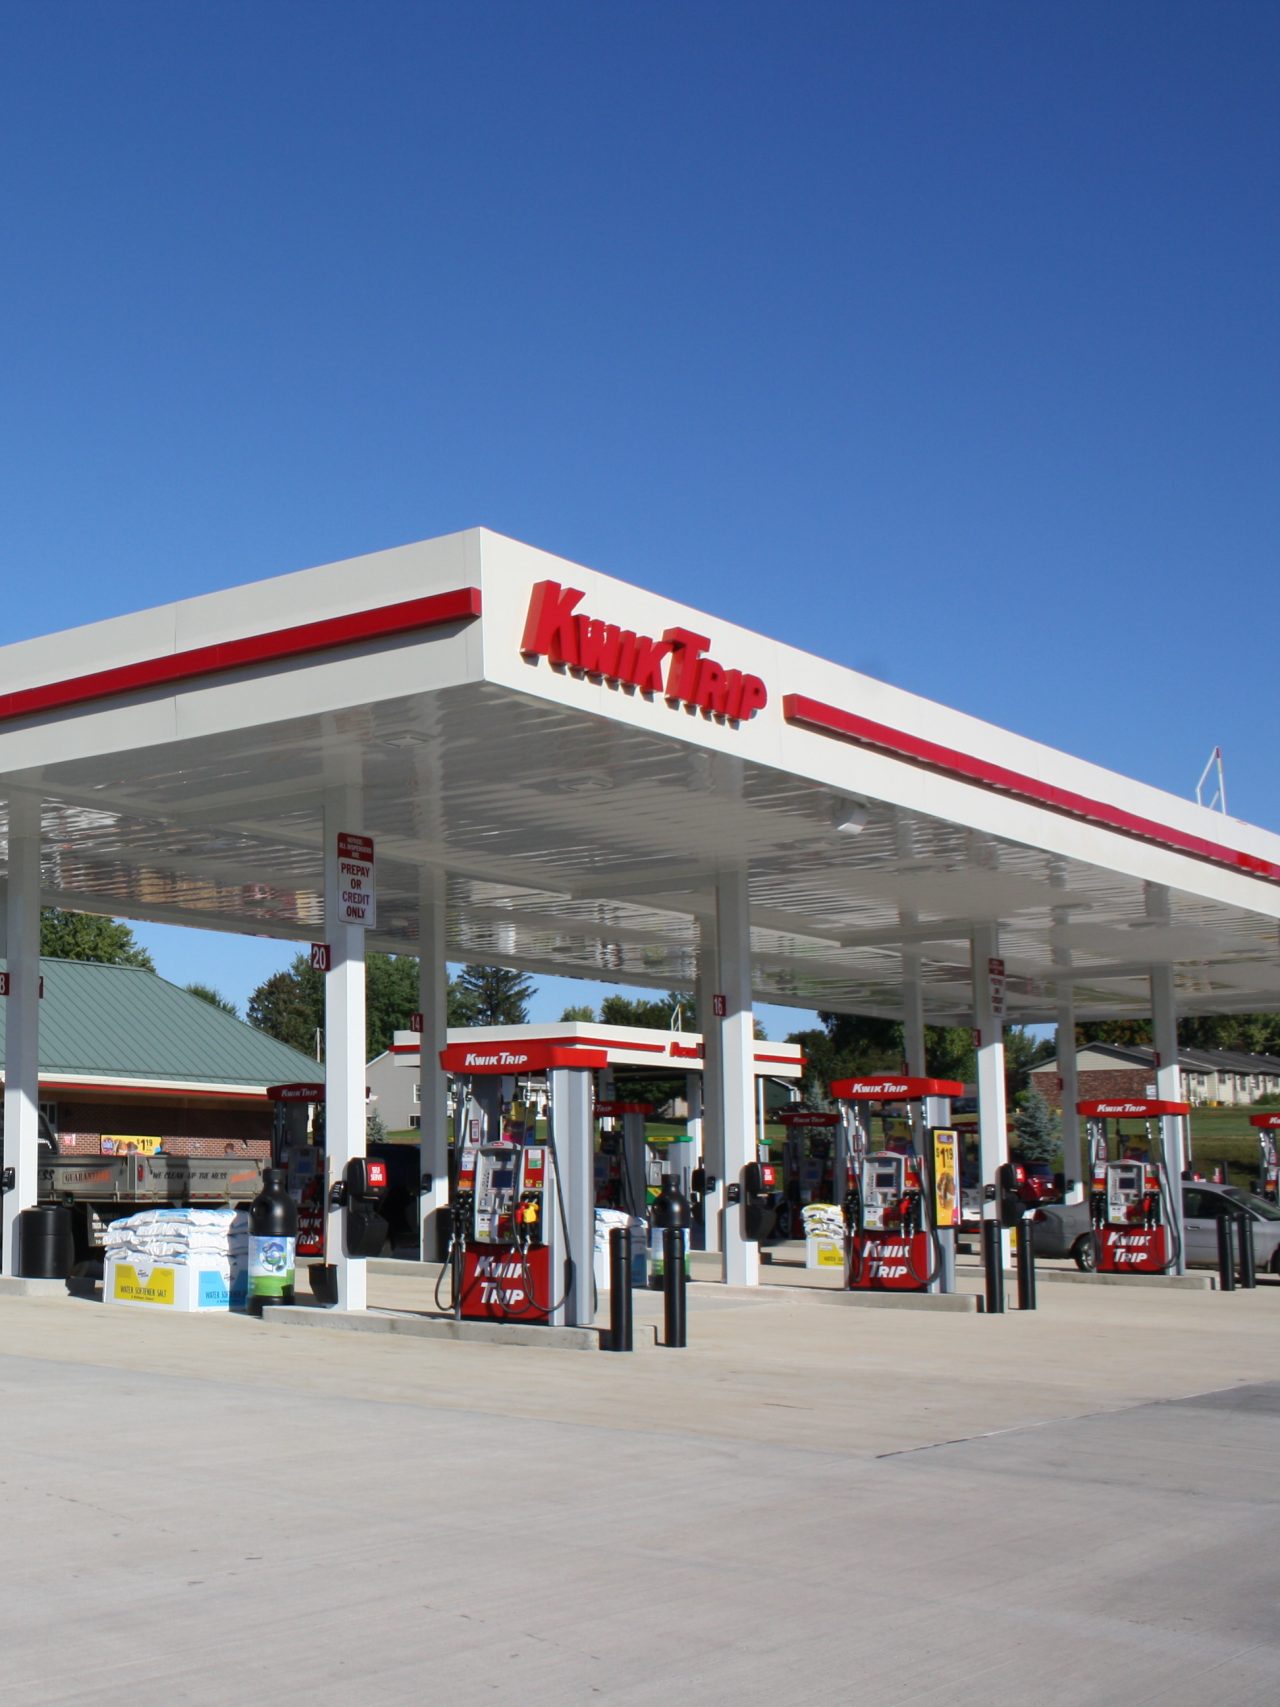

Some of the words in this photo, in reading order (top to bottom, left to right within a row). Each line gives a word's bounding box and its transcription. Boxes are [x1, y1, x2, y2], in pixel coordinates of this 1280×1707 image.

[520, 580, 673, 692] KWIK
[662, 627, 767, 720] TRIP
[341, 862, 370, 878] PREPAY
[350, 878, 362, 891] OR
[342, 890, 370, 906] CREDIT
[346, 905, 366, 919] ONLY
[313, 946, 326, 970] 20
[464, 1053, 498, 1066] KWIK
[499, 1052, 528, 1065] TRIP
[852, 1083, 881, 1093] KWIK
[882, 1082, 908, 1093] TRIP
[1096, 1104, 1123, 1112] KWIK
[1123, 1103, 1147, 1112] TRIP
[1107, 1231, 1151, 1246] KWIK
[863, 1241, 910, 1257] KWIK
[1114, 1248, 1148, 1263] TRIP
[474, 1256, 530, 1278] KWIK
[869, 1261, 908, 1278] TRIP
[481, 1282, 524, 1304] TRIP
